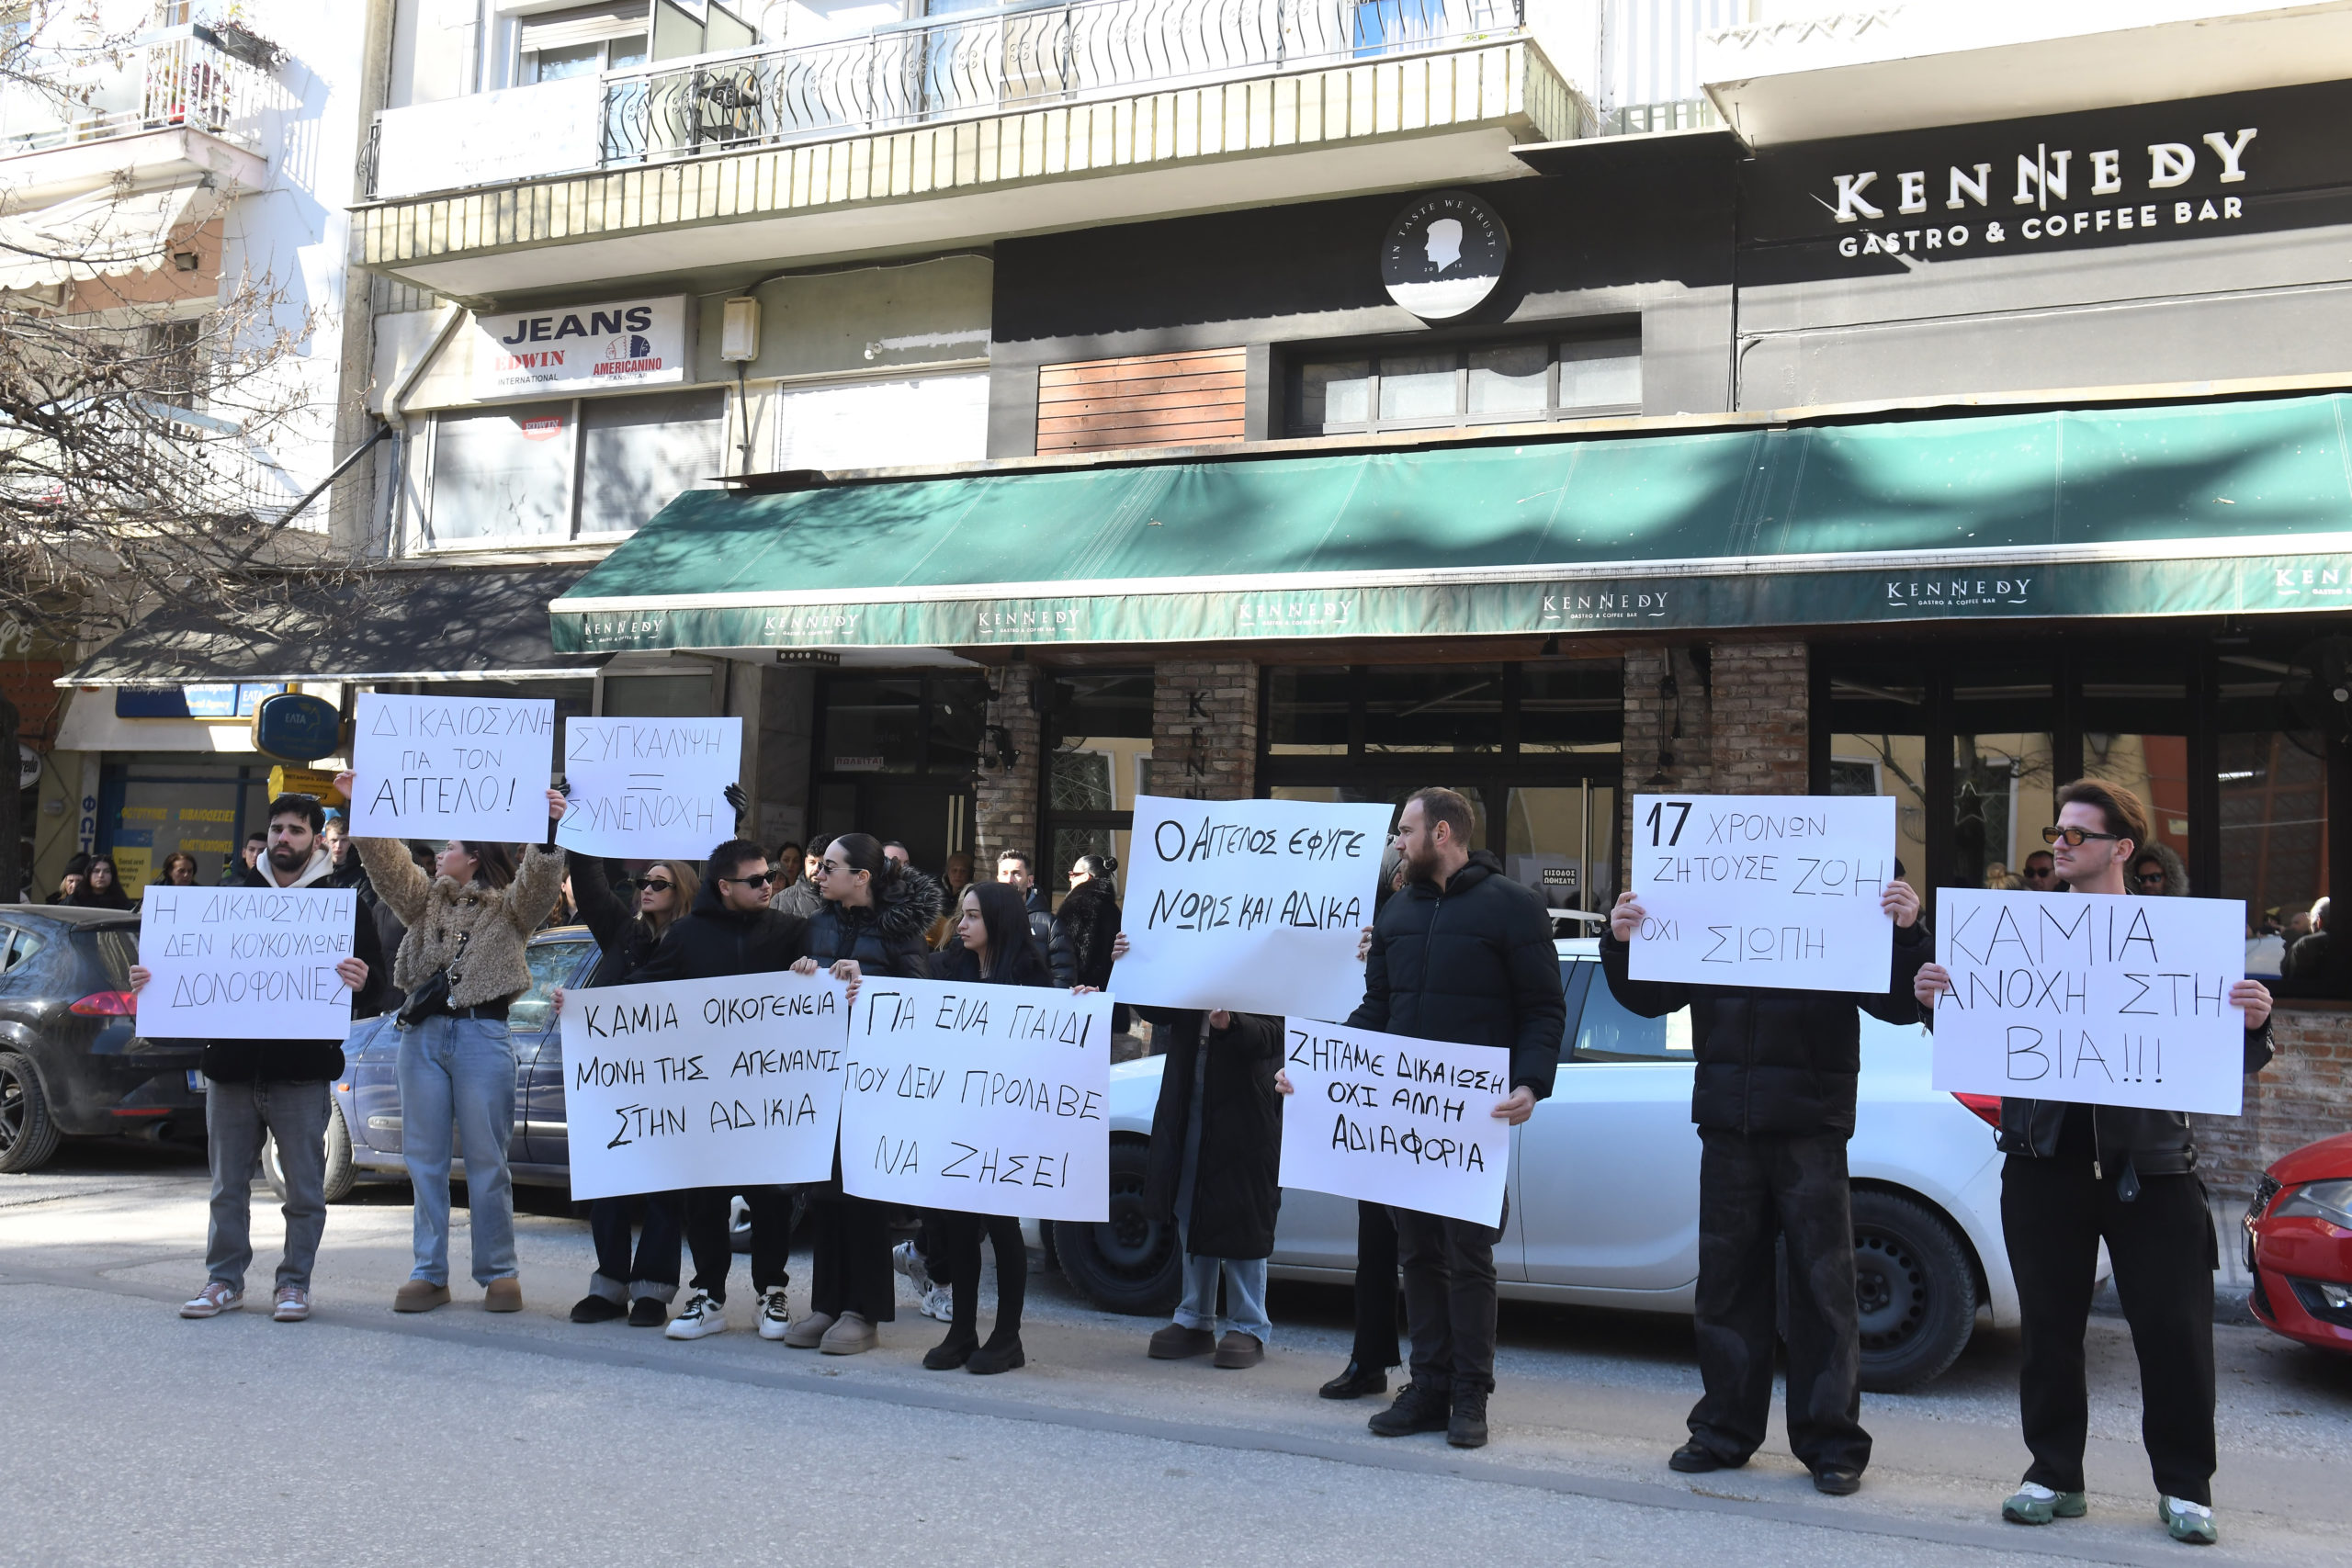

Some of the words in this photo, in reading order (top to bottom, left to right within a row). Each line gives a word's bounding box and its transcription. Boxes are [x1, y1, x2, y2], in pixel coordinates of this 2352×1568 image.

[1833, 128, 2257, 223] KENNEDY
[1392, 245, 1401, 260] IN
[1397, 202, 1435, 237] TASTE
[1444, 199, 1464, 209] WE
[1471, 206, 1496, 247] TRUST
[1838, 225, 1969, 258] GASTRO
[1985, 221, 2006, 243] &
[2021, 204, 2156, 240] COFFEE
[2175, 196, 2243, 224] BAR
[503, 306, 652, 345] JEANS
[495, 349, 566, 372] EDWIN
[498, 373, 559, 387] INTERNATIONAL
[593, 356, 662, 376] AMERICANINO
[605, 372, 648, 382] JEANSWEAR
[526, 419, 559, 430] EDWIN
[1886, 578, 2032, 599] KENNEDY
[2276, 568, 2352, 587] KEN
[978, 609, 1080, 626] KENNEDY
[1238, 601, 1352, 620] KENNEDY
[1544, 591, 1668, 612] KENNEDY
[1955, 598, 1979, 606] COFFEE
[585, 619, 663, 636] KENNEDY
[764, 615, 859, 629] KENNEDY
[285, 713, 307, 725] ΕΛΤΑ
[372, 705, 553, 738] ΔΙΚΑΙΟΣΥΝΗ
[401, 750, 431, 771] ΓΙΑ
[453, 749, 503, 770] ΤΟΝ
[569, 726, 721, 761] ΣΥΓΚΑΛΥΨΗ
[560, 795, 714, 834] ΣΥΝΕΝΟΧΗ
[1645, 802, 1693, 847] 17
[1706, 813, 1826, 844] ΧΡΟΝΩΝ
[1155, 819, 1186, 862] Ο
[1188, 816, 1277, 863] ΑΓΓΕΛΟΣ
[1288, 828, 1366, 862] ΕΦΥΓΕ
[1654, 855, 1779, 883] ΖΗΤΟΥΣΕ
[1792, 858, 1883, 897] ΖΩΗ
[154, 895, 178, 924] Η
[202, 895, 348, 924] ΔΙΚΑΙΟΣΥΝΗ
[1148, 888, 1233, 932] ΝΩΡΙΣ
[1238, 893, 1273, 931] ΚΑΙ
[1280, 890, 1361, 931] ΑΔΙΚΑ
[164, 933, 213, 957] ΔΕΝ
[231, 932, 353, 960] ΚΟΥΚΟΥΛΩΝΕΙ
[1640, 917, 1679, 942] ΟΧΙ
[1702, 925, 1826, 964] ΣΙΩΠΗ
[1950, 902, 2158, 966] ΚΑΜΙΑ
[172, 964, 352, 1008] ΔΟΛΟΦΟΝΙΕΣ
[1938, 968, 2087, 1015] ΑΝΟΧΗ
[2119, 972, 2223, 1018] ΣΤΗ
[584, 1002, 679, 1039] ΚΑΜΙΑ
[704, 990, 835, 1028] ΟΙΚΟΓΕΝΕΙΑ
[868, 992, 916, 1036] ΓΙΑ
[935, 996, 989, 1037] ΕΝΑ
[1009, 1005, 1092, 1049] ΠΑΙΔΙ
[577, 1056, 645, 1091] ΜΟΝΗ
[654, 1055, 709, 1085] ΤΗΣ
[730, 1048, 842, 1079] ΑΠΕΝΑΝΤΙ
[1288, 1030, 1386, 1077] ΖΗΤΑΜΕ
[1396, 1051, 1505, 1095] ΔΙΚΑΙΩΣΗ
[2007, 1025, 2163, 1084] ΒΙΑ!!!
[845, 1062, 889, 1093] ΠΟΥ
[898, 1064, 945, 1100] ΔΕΝ
[961, 1070, 1102, 1121] ΠΡΟΛΑΒΕ
[1328, 1081, 1378, 1108] ΟΧΙ
[606, 1103, 686, 1149] ΣΤΗΝ
[710, 1093, 817, 1134] ΑΔΙΚΙΑ
[876, 1135, 918, 1175] ΝΑ
[941, 1142, 1069, 1188] ΖΗΣΕΙ
[1332, 1113, 1485, 1173] ΑΔΙΑΦΟΡΙΑ
